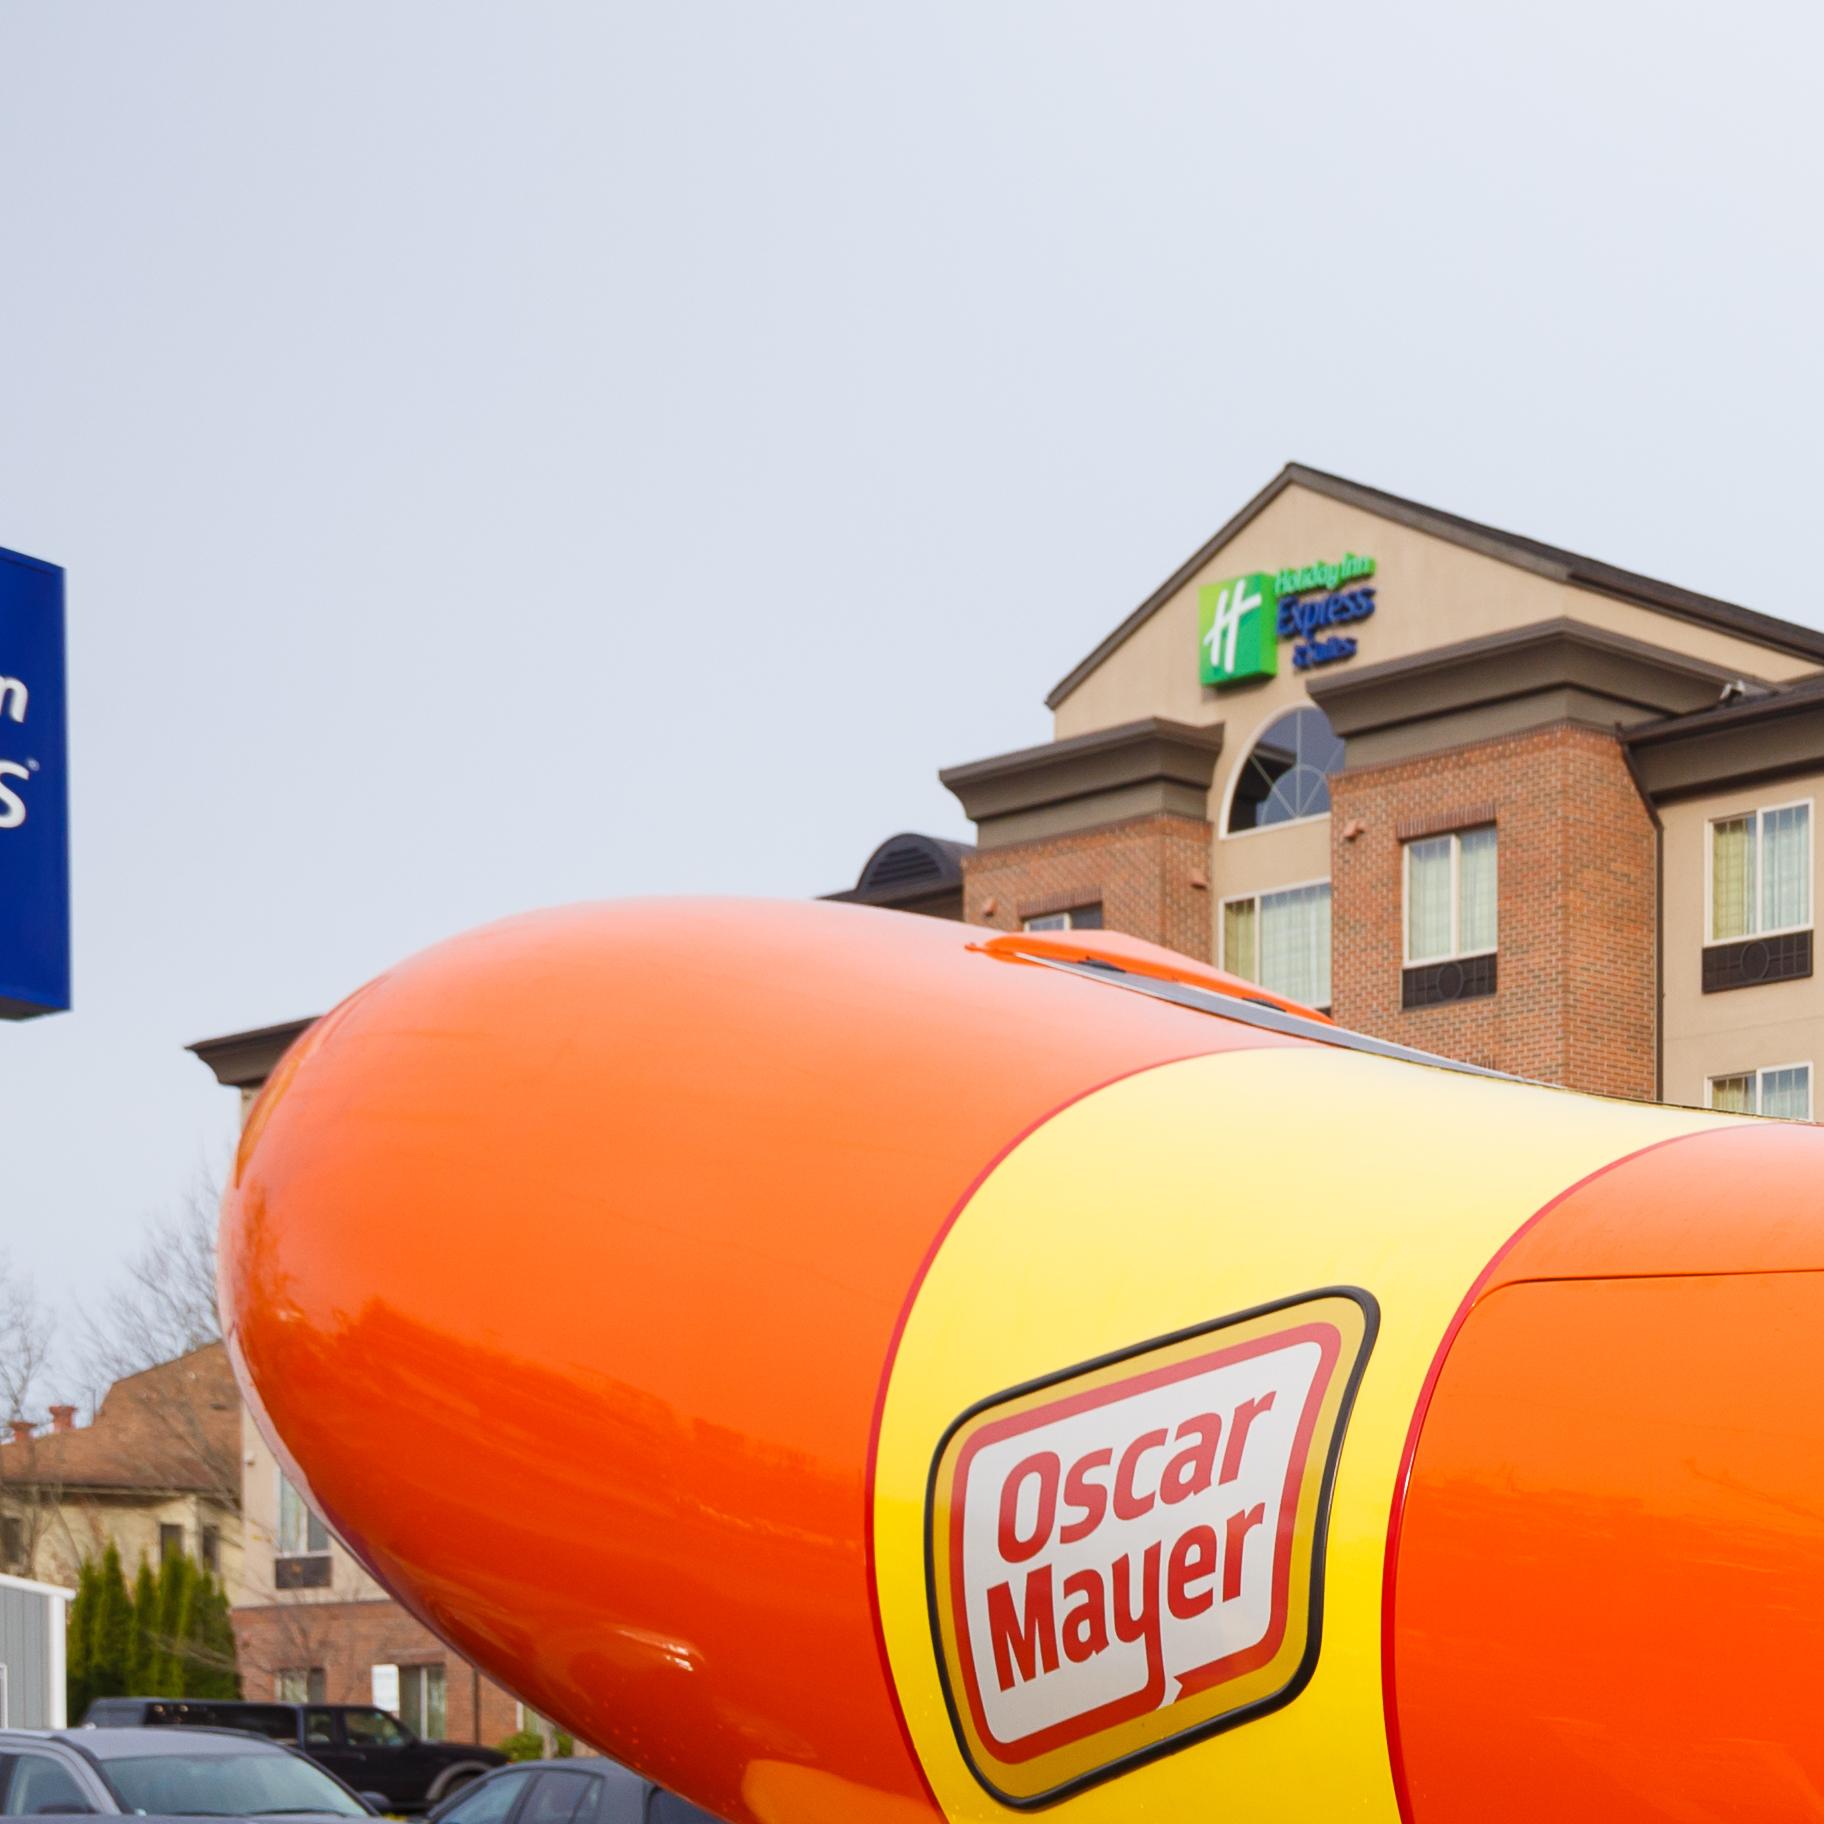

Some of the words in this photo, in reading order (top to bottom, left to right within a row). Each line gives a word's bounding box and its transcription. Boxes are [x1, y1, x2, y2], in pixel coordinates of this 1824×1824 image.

[1276, 589, 1376, 640] Express
[997, 1390, 1277, 1564] Oscar
[986, 1502, 1266, 1704] Mayer
